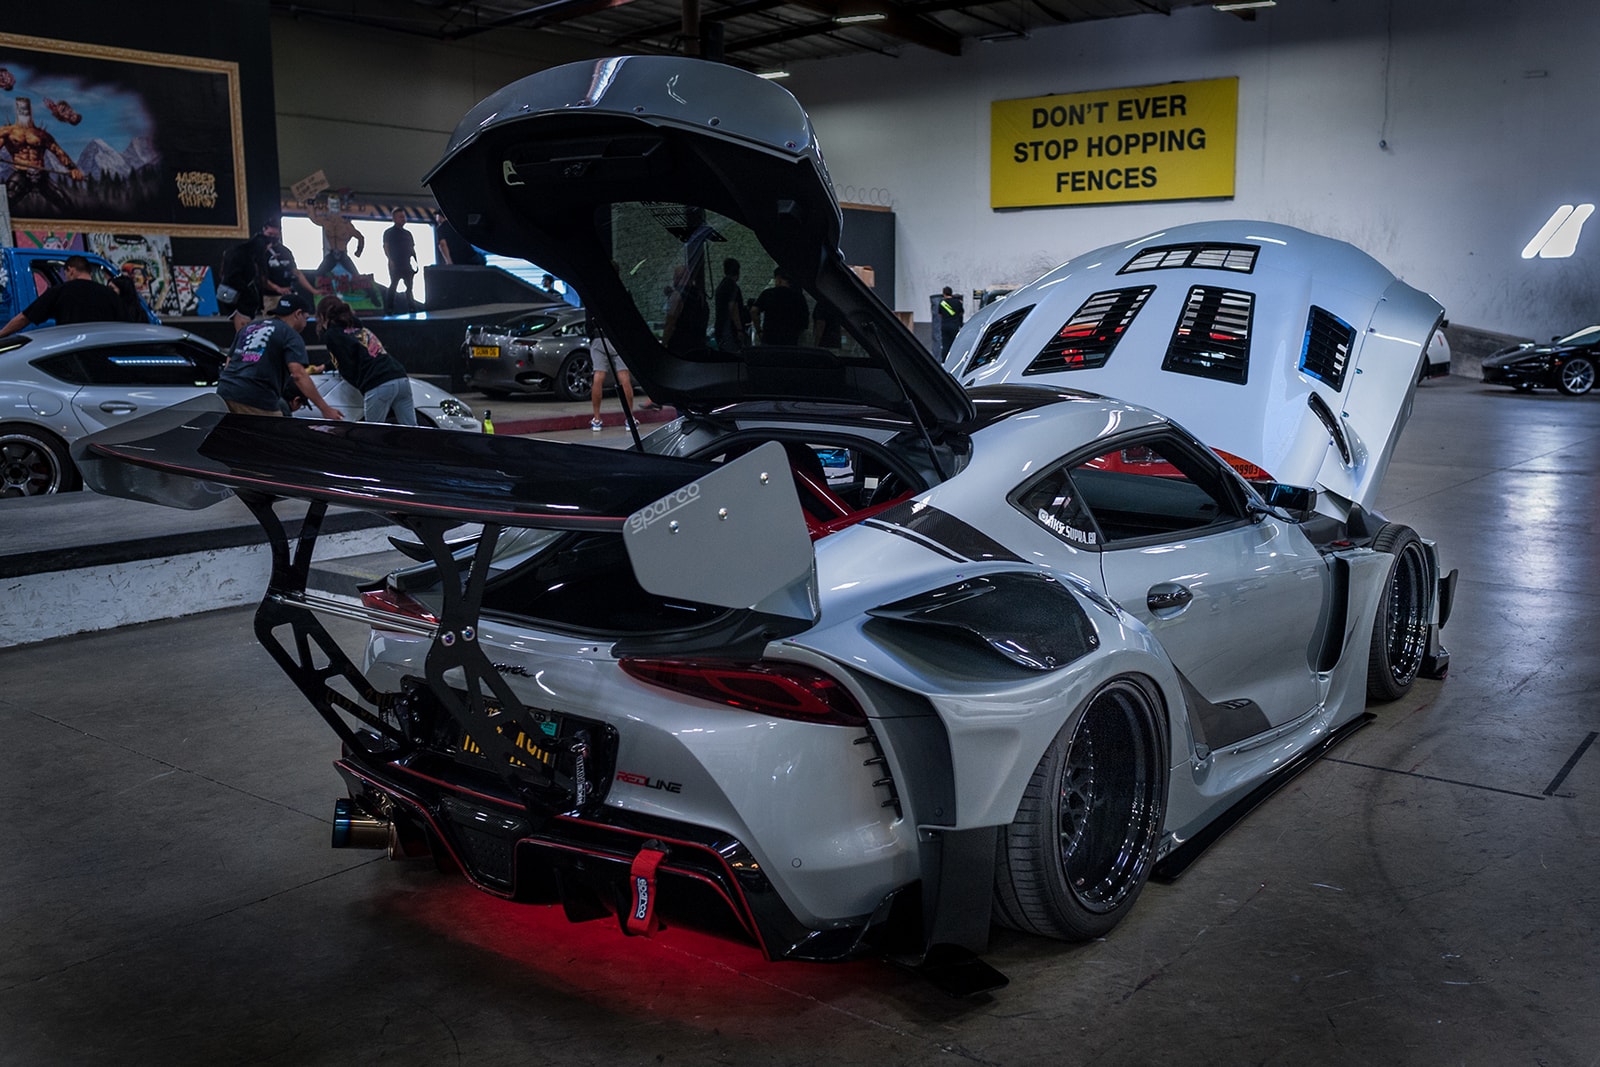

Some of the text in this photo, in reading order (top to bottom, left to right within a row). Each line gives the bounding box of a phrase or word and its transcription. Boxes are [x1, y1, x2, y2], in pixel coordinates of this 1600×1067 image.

[1032, 94, 1187, 129] DON'T EVER
[1013, 128, 1206, 163] STOP HOPPING
[1056, 166, 1158, 193] FENCES
[630, 483, 700, 532] sparco
[616, 771, 682, 794] REDLINE
[635, 877, 648, 919] sparco
